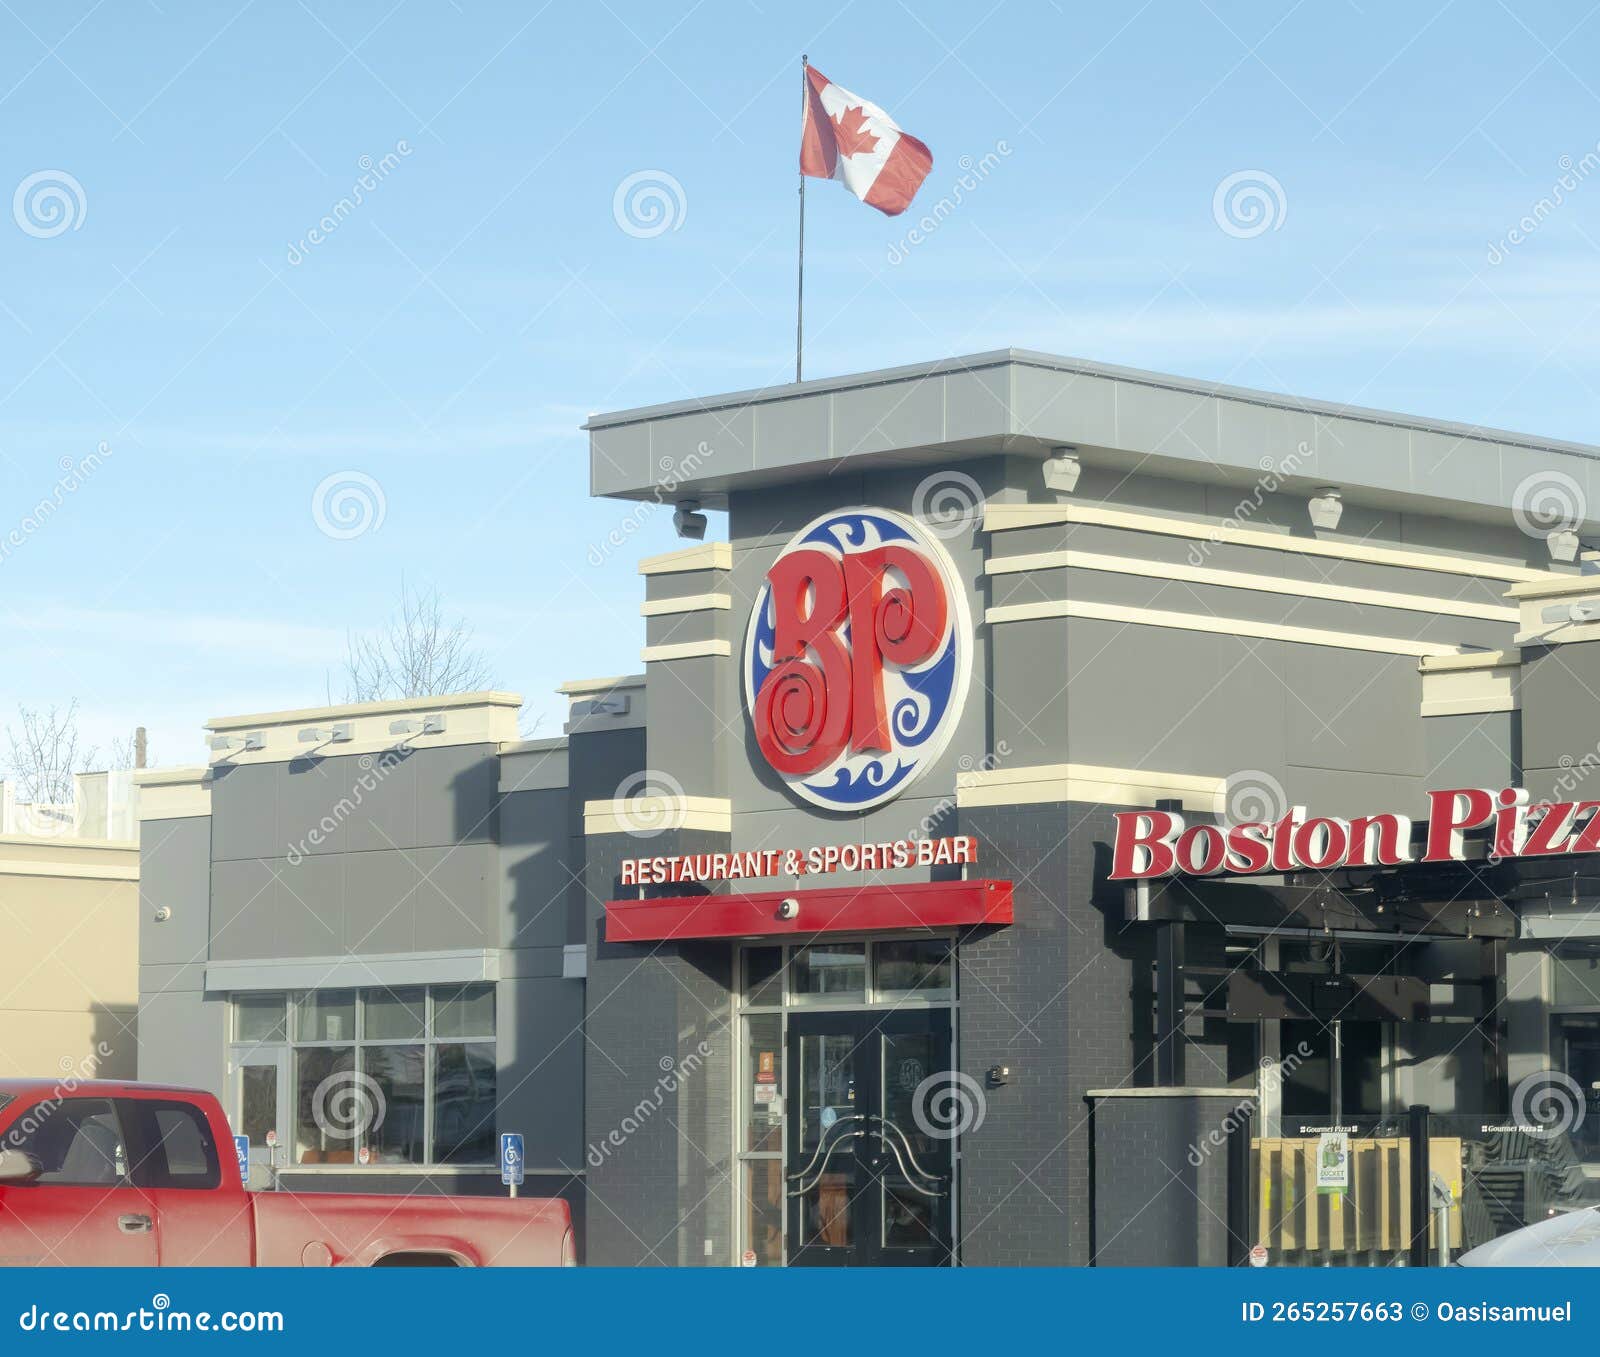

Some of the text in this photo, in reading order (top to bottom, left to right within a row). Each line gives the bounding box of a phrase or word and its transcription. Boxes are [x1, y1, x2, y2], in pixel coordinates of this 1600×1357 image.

[755, 545, 948, 775] BP
[621, 835, 975, 886] RESTAURANT & SPORTS BAR
[1108, 805, 1413, 880] Boston
